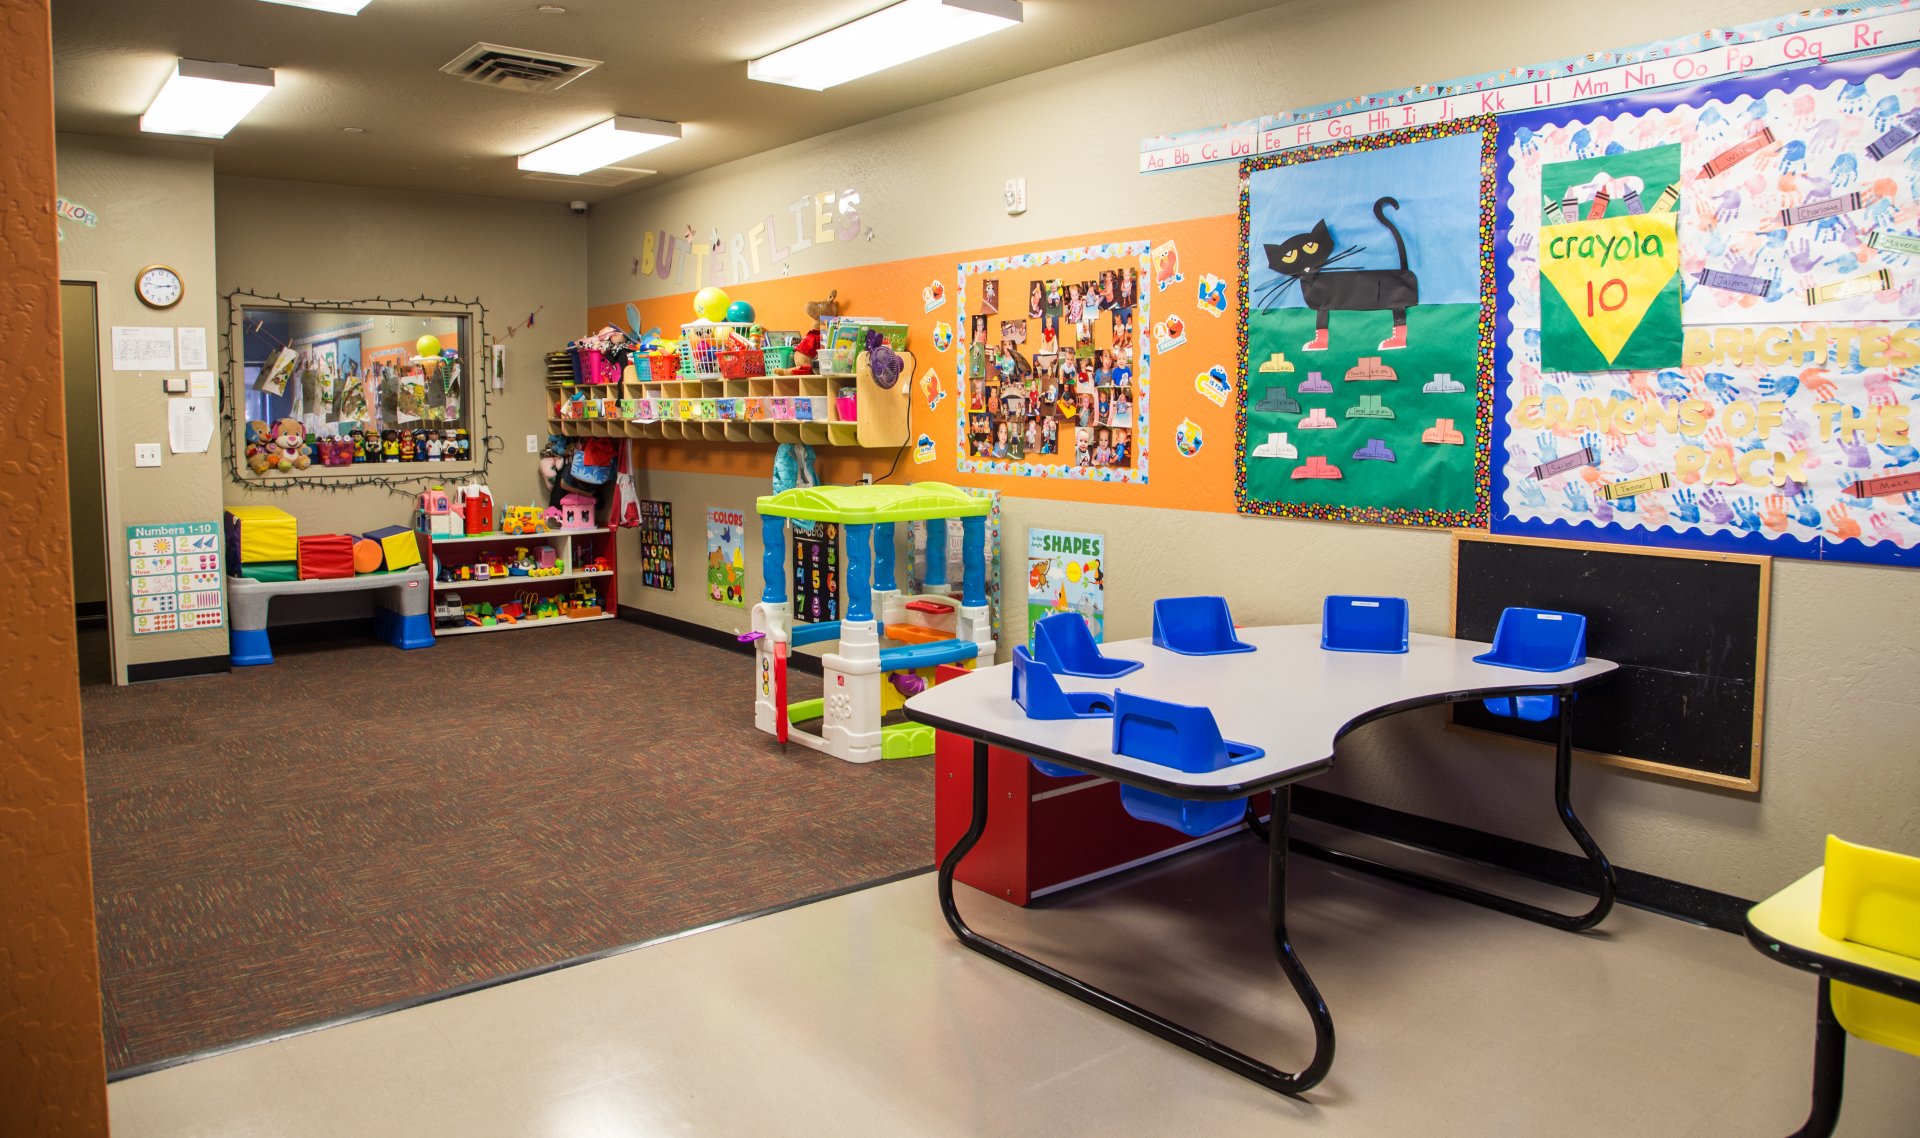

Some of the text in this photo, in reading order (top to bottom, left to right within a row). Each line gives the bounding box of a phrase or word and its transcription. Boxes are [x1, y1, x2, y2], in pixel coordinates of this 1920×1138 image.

[1147, 23, 1883, 169] Aa Bb Cc Dd Ee Ff Gg Hh Ii Jj Kk Ll Mm Nn Oo Pp Qq Rr
[56, 199, 95, 225] AILOR
[641, 188, 861, 290] BUTTERFLIES
[1549, 230, 1664, 268] crayola
[1587, 278, 1628, 318] 10
[1516, 396, 1910, 446] CRAYONS OF THE
[1551, 459, 1574, 473] Sailor
[1675, 446, 1808, 487] PACK
[1620, 482, 1647, 493] Tanner
[664, 504, 670, 517] C
[713, 511, 743, 527] COLORS
[135, 524, 212, 537] Numbers 1-10
[135, 537, 189, 551] 1 2
[1042, 535, 1100, 557] SHAPES
[136, 556, 188, 569] 3 4
[138, 574, 190, 588] 5 6
[812, 569, 821, 589] 5
[827, 572, 837, 592] 6
[139, 593, 191, 608] 7 8
[138, 613, 195, 627] 9 10
